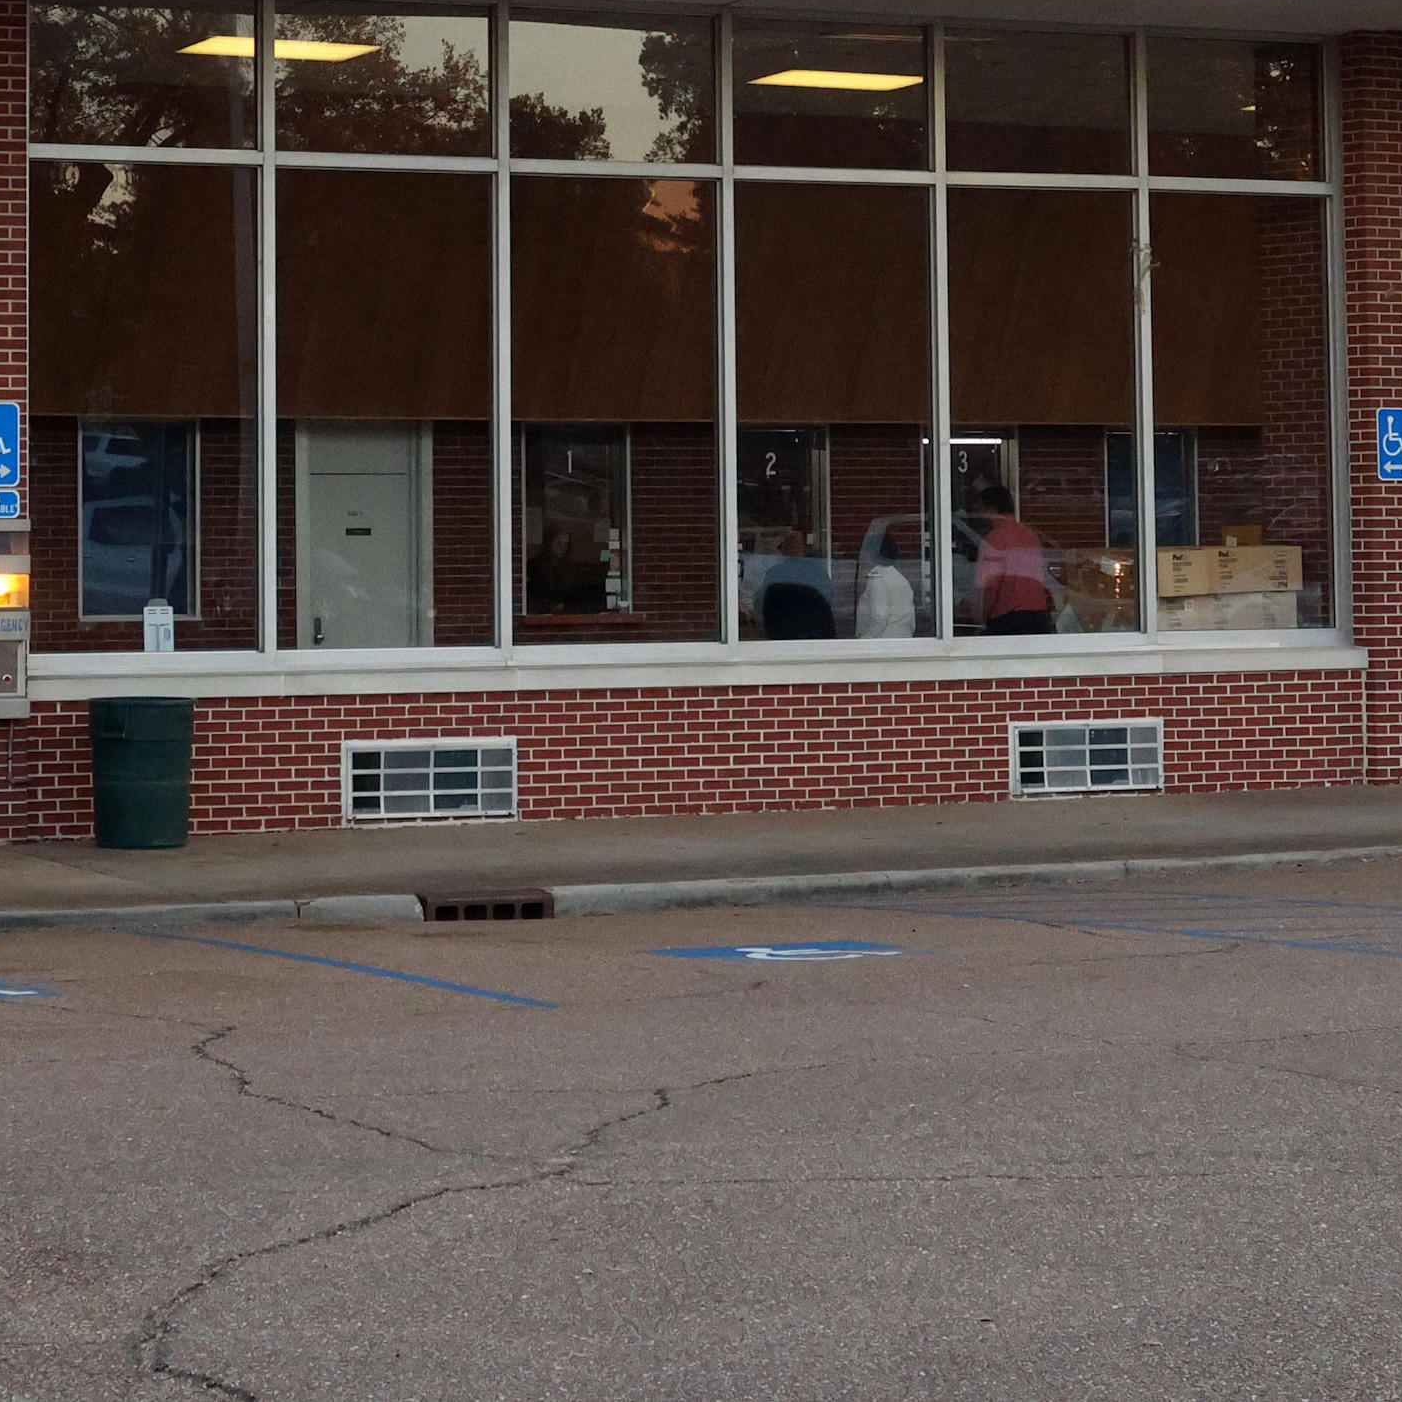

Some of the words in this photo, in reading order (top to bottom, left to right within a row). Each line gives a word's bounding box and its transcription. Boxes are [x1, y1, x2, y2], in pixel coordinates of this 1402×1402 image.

[566, 450, 572, 474] 1
[765, 452, 776, 476] 2
[958, 450, 968, 473] 3
